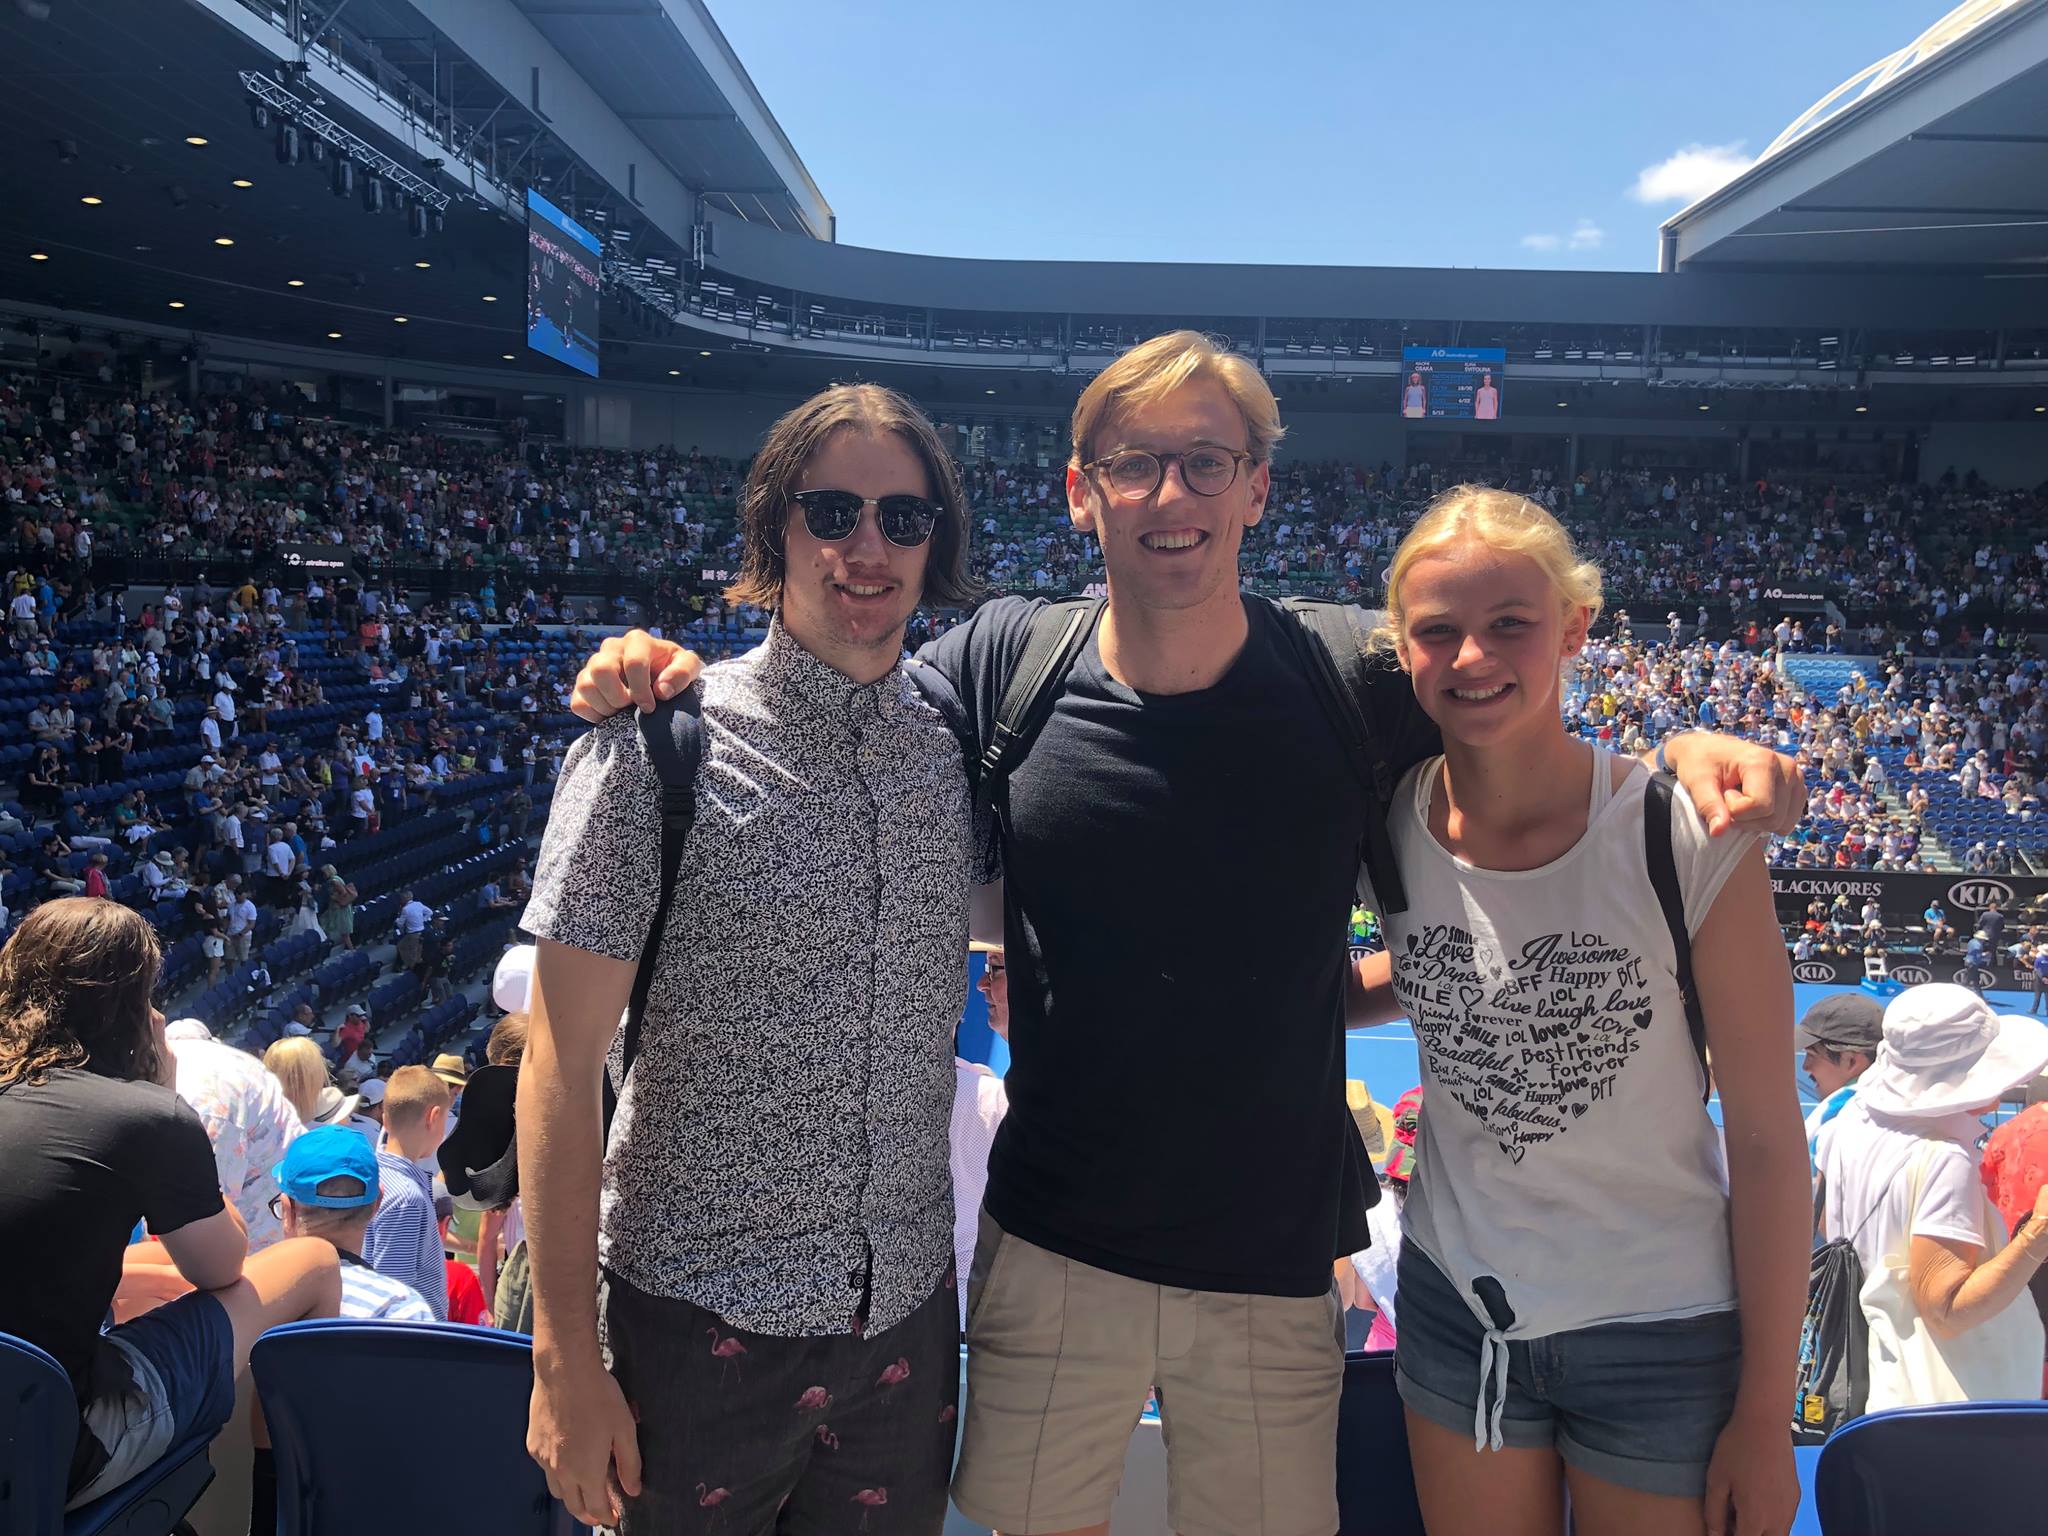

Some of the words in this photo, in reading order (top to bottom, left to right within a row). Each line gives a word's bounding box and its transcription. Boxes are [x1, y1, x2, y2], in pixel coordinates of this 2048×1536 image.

[1763, 588, 1782, 599] AO
[1771, 880, 1881, 896] BLACKMORES
[1959, 886, 2001, 904] KIA
[1571, 931, 1609, 948] LOL
[1508, 934, 1631, 972] Awesome
[1418, 960, 1487, 984] Dance
[1548, 966, 1611, 989] Happy
[1800, 966, 1830, 979] KIA
[1896, 971, 1926, 983] KIA
[1393, 972, 1452, 1006] SMILE
[1505, 974, 1542, 995] BFF
[1550, 987, 1576, 1006] LOL
[1488, 988, 1532, 1014] live
[1535, 995, 1599, 1029] laugh
[1602, 989, 1651, 1012] love
[1460, 1022, 1500, 1047] SMILE
[1506, 1031, 1527, 1046] LOL
[1528, 1022, 1570, 1044] love
[1423, 1035, 1513, 1071] Beautiful
[1547, 1056, 1629, 1080] forever
[1474, 1086, 1493, 1102] LOL
[1485, 1074, 1525, 1096] SMILE
[1591, 1074, 1616, 1101] BFF
[1523, 1090, 1565, 1105] Happy
[1513, 1131, 1554, 1145] Happy
